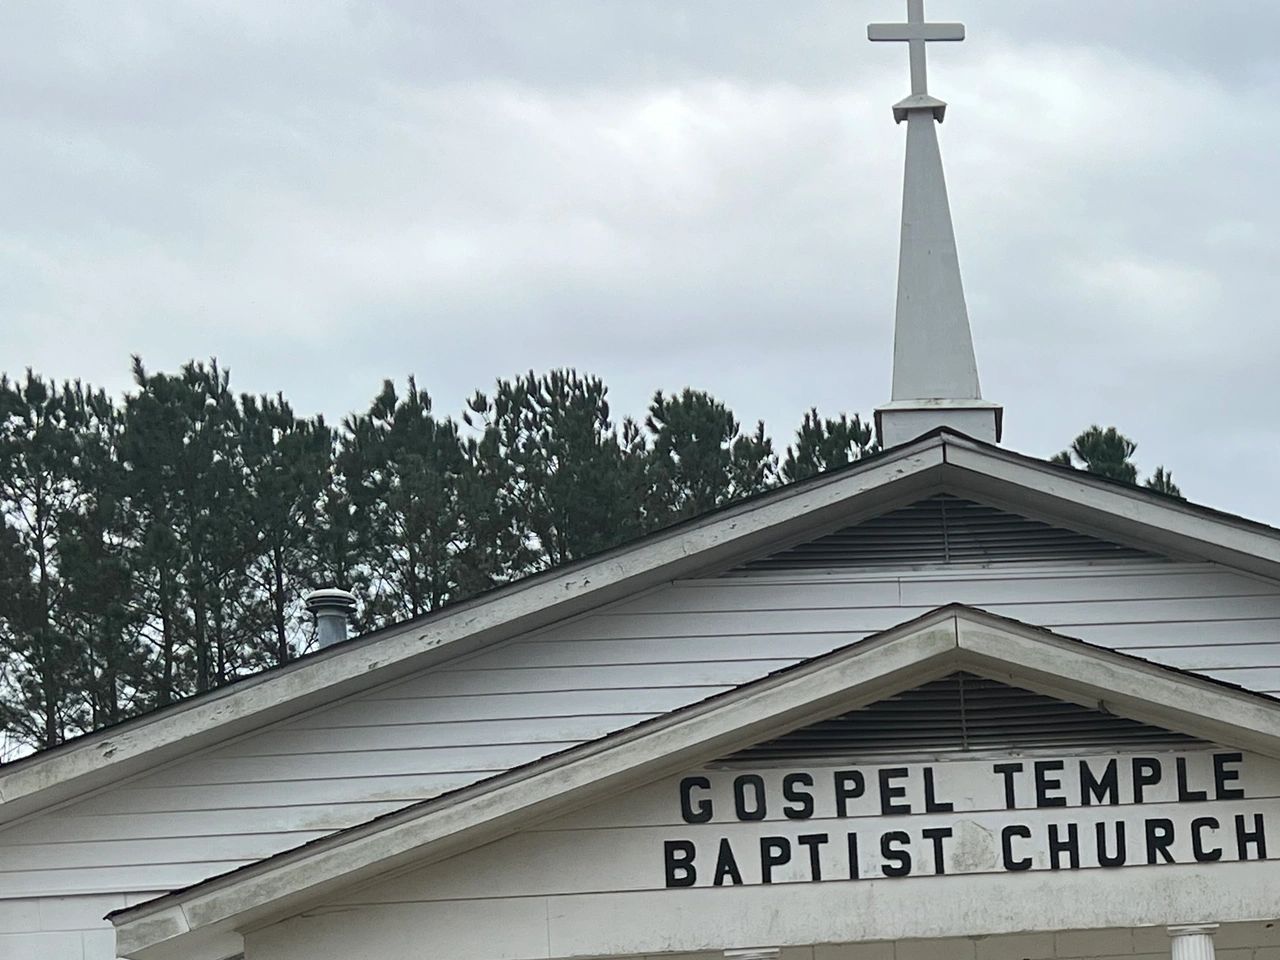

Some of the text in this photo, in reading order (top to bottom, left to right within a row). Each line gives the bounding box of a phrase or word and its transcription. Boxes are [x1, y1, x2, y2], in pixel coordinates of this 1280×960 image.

[679, 752, 1245, 824] GOSPEL TEMPLE
[664, 813, 1268, 888] BAPTIST CHURCH
